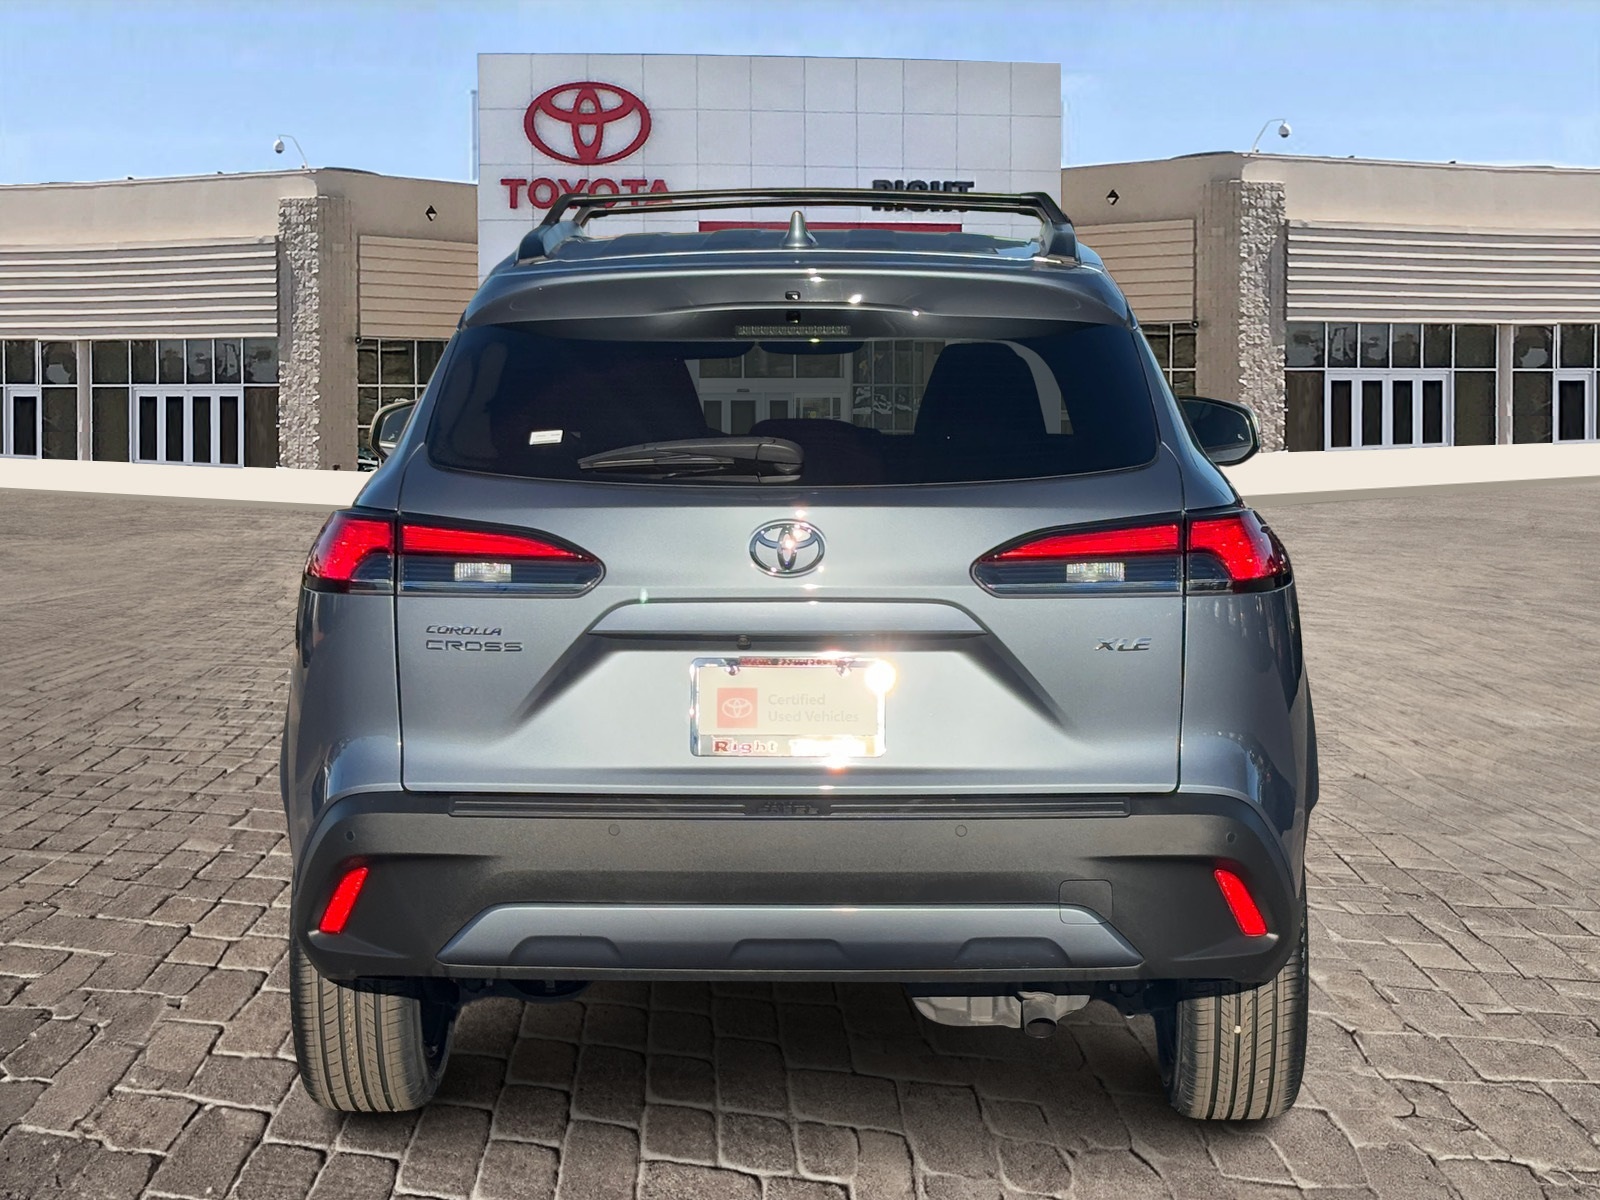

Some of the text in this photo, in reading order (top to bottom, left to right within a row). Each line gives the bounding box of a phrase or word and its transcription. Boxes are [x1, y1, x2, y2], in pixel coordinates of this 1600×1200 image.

[500, 177, 673, 210] TOYOTA
[425, 625, 502, 636] COROLLA
[425, 640, 523, 652] CROSS
[1094, 637, 1152, 652] XLE
[768, 693, 826, 705] Certified
[768, 710, 859, 722] Used Vehicles
[713, 740, 776, 753] Right
